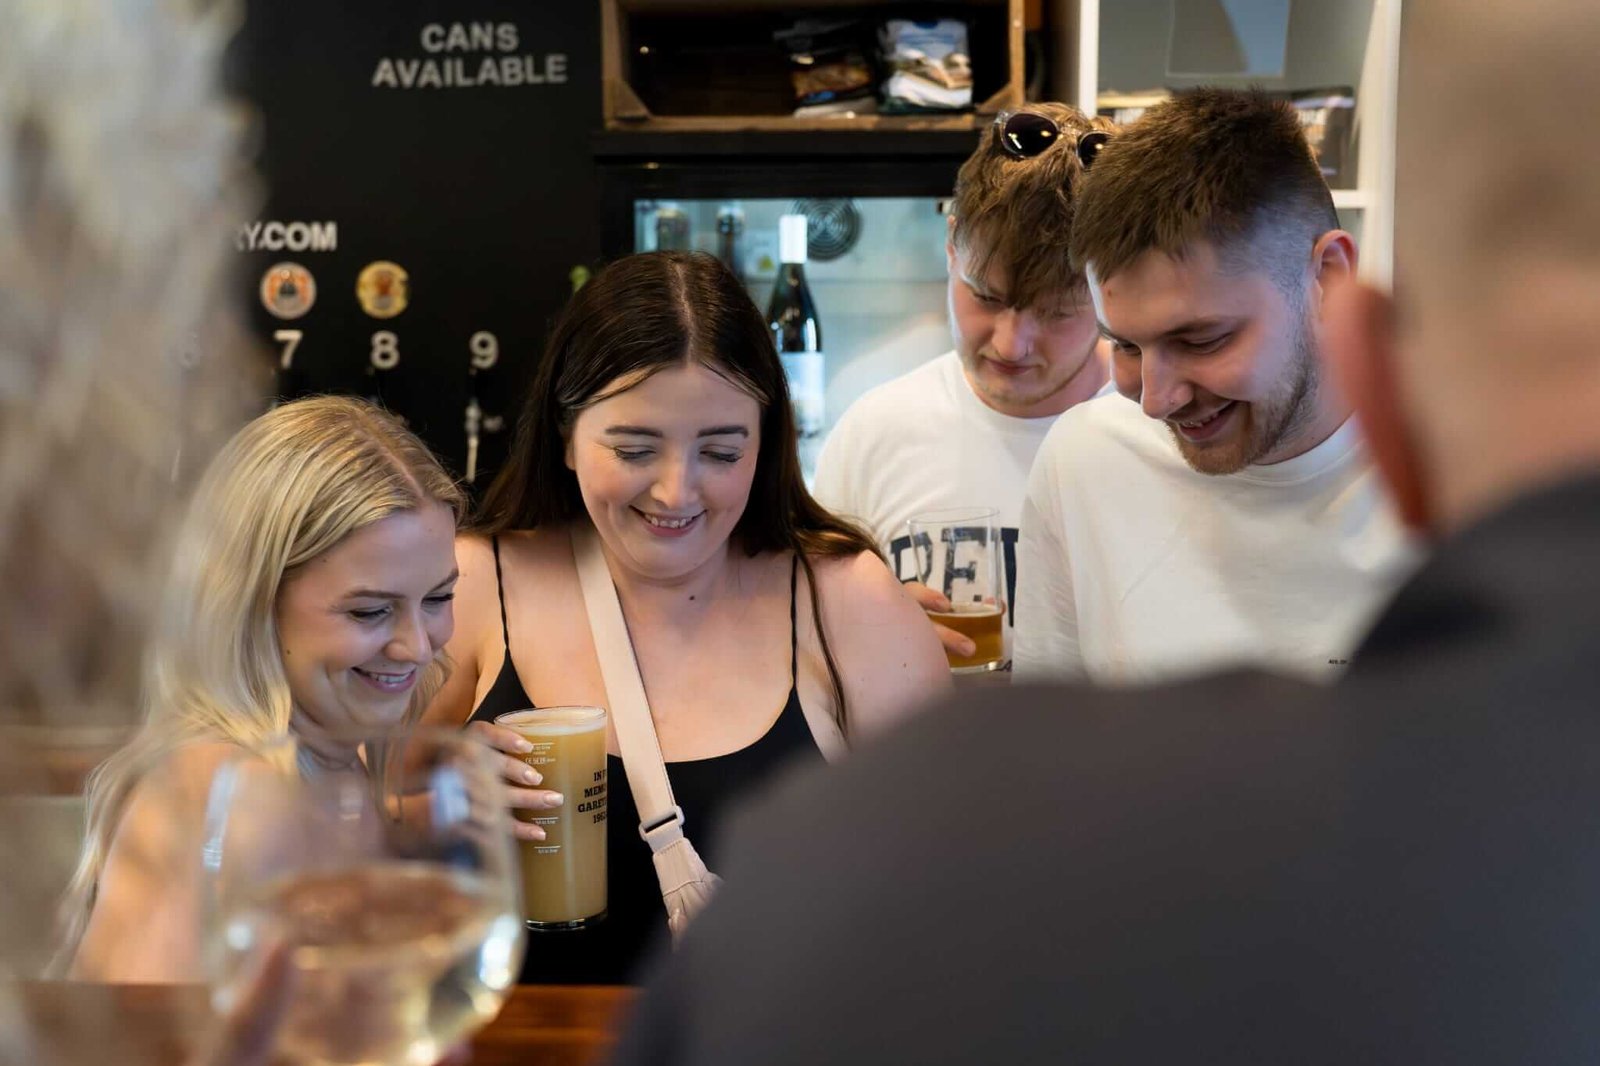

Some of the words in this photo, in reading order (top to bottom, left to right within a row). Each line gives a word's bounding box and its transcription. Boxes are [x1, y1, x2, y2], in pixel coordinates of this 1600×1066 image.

[420, 23, 519, 52] CANS
[372, 54, 568, 88] AVAILABLE
[274, 330, 302, 369] 7
[371, 331, 400, 369] 8
[470, 331, 499, 369] 9
